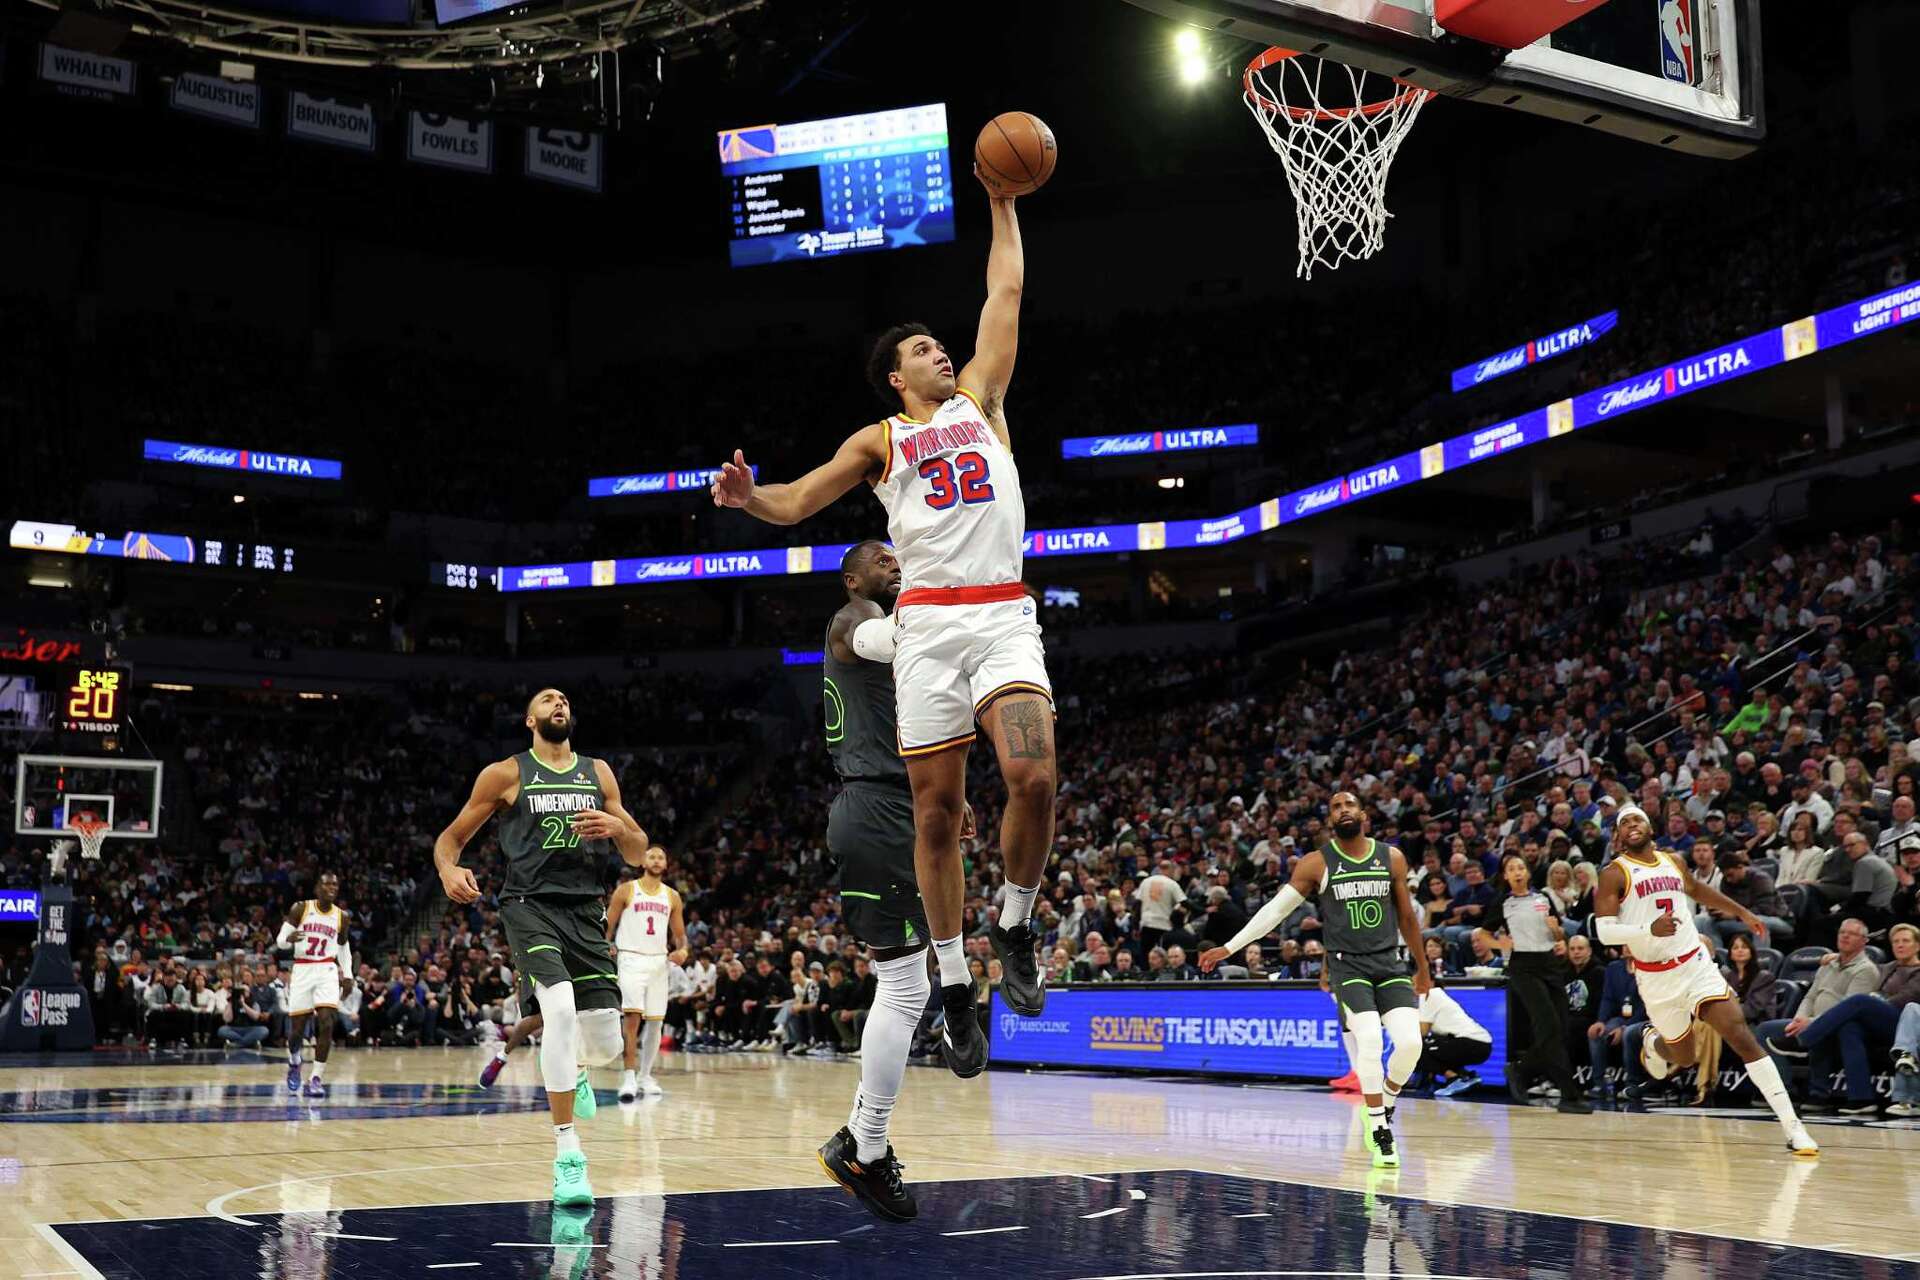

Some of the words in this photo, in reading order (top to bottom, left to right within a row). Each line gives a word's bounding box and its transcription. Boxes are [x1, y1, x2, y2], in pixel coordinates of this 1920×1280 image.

[54, 55, 121, 82] WHALEN
[1667, 60, 1682, 78] NBA
[177, 77, 255, 110] AUGUSTUS
[296, 105, 370, 133] BRUNSON
[422, 131, 478, 155] FOWLES
[540, 150, 587, 174] MOORE
[1860, 285, 1920, 317] SUPERIOR
[1853, 309, 1891, 334] LIGHT
[1536, 323, 1592, 358] ULTRA
[1678, 348, 1751, 387] ULTRA
[900, 420, 992, 467] WARRIORS
[1165, 428, 1227, 448] ULTRA
[251, 453, 313, 476] ULTRA
[918, 451, 995, 510] 32
[1350, 465, 1400, 495] ULTRA
[33, 530, 44, 545] 9
[1047, 532, 1109, 551] ULTRA
[705, 555, 762, 574] ULTRA
[79, 670, 119, 690] 6:42
[69, 686, 114, 719] 20
[79, 722, 120, 732] TISSOT
[528, 793, 596, 815] TIMBERWOLVES
[1332, 880, 1391, 901] TIMBERWOLVES
[49, 905, 64, 918] GET
[1346, 899, 1383, 930] 10
[50, 917, 64, 930] THE
[646, 916, 655, 935] 1
[305, 937, 328, 956] 71
[42, 990, 80, 1010] League
[41, 1007, 68, 1026] Pass
[1091, 1016, 1165, 1042] SOLVING
[1164, 1017, 1203, 1044] THE
[1205, 1017, 1339, 1048] UNSOLVABLE
